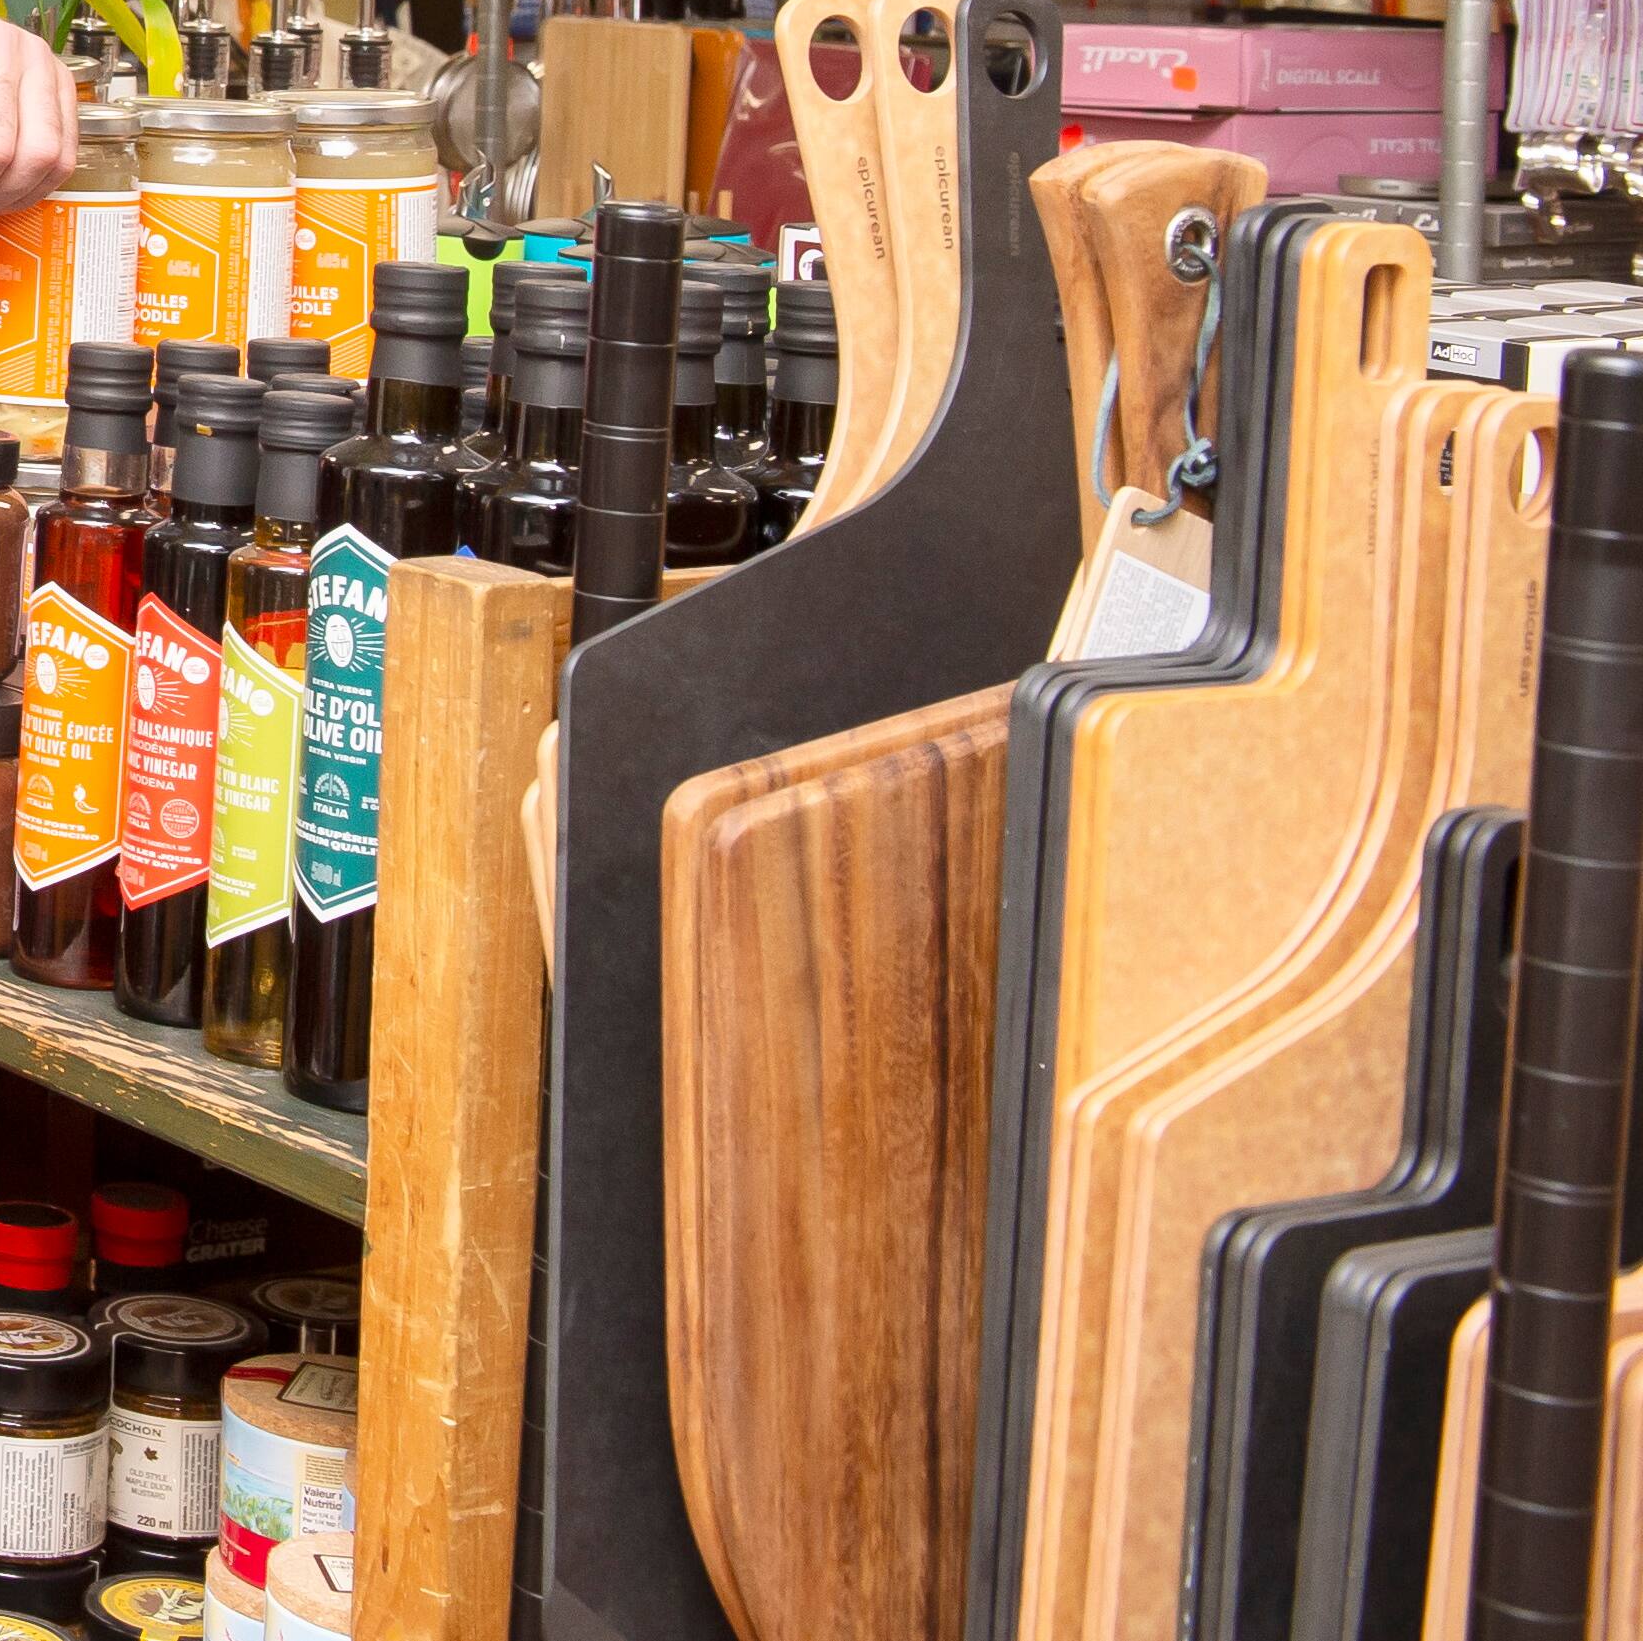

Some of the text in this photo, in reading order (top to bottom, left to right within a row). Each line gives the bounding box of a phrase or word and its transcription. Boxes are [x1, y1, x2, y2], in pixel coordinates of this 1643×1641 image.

[857, 156, 886, 260] epicurean
[934, 145, 955, 250] epicurean
[66, 719, 114, 744] ÉPICÉE
[138, 723, 214, 749] BALSAMIQUE
[35, 739, 93, 761] OLIVE OIL
[143, 759, 197, 781] VINEGAR
[240, 772, 280, 795] BLANC
[226, 789, 271, 813] VINEGAR
[313, 801, 349, 821] ITALIA
